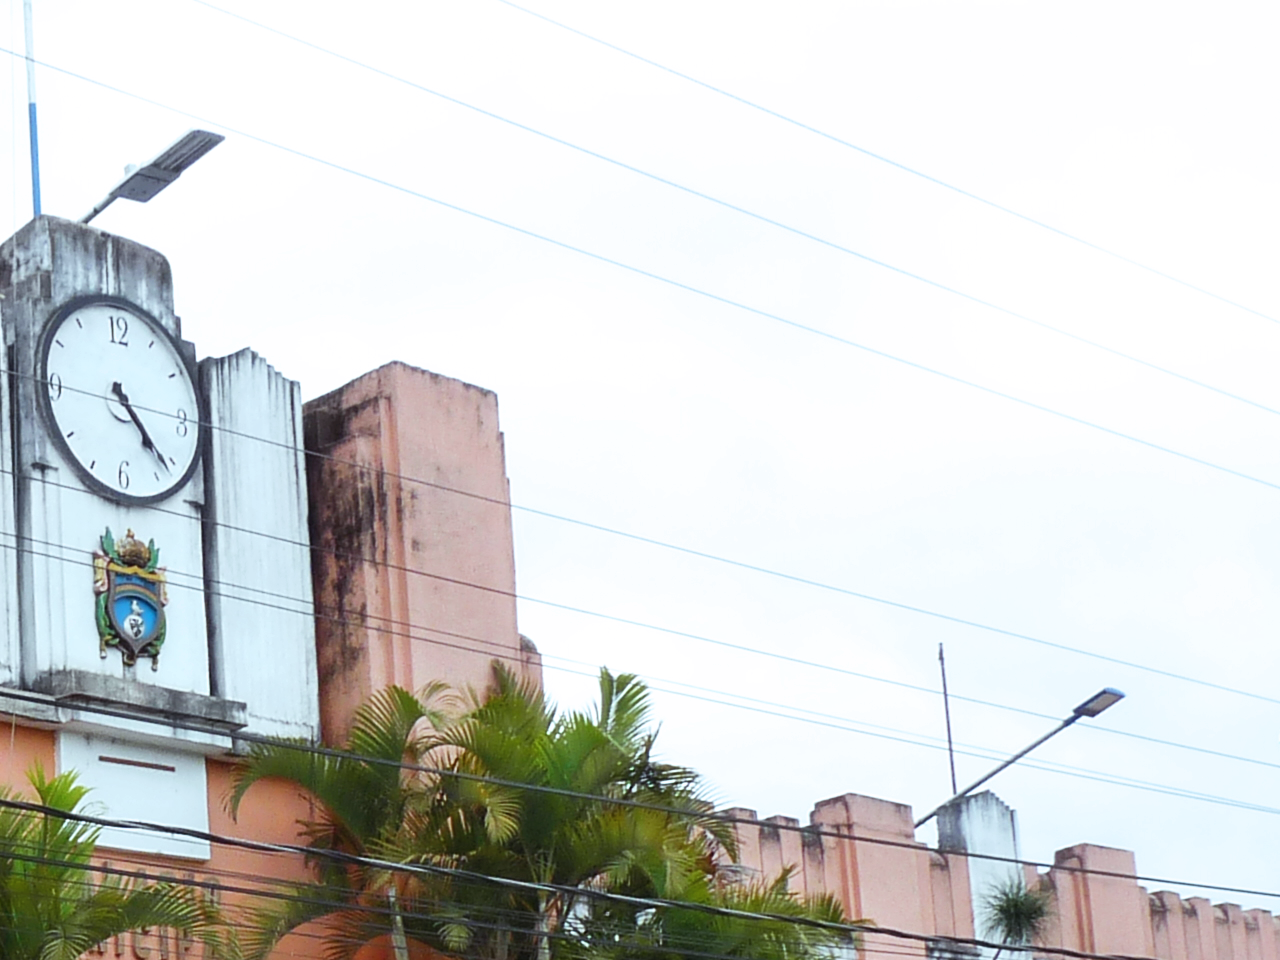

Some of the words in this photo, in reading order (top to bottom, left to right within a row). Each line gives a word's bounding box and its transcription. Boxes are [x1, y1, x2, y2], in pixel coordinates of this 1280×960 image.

[109, 316, 129, 347] 12
[49, 372, 62, 401] 9
[119, 460, 130, 489] 6
